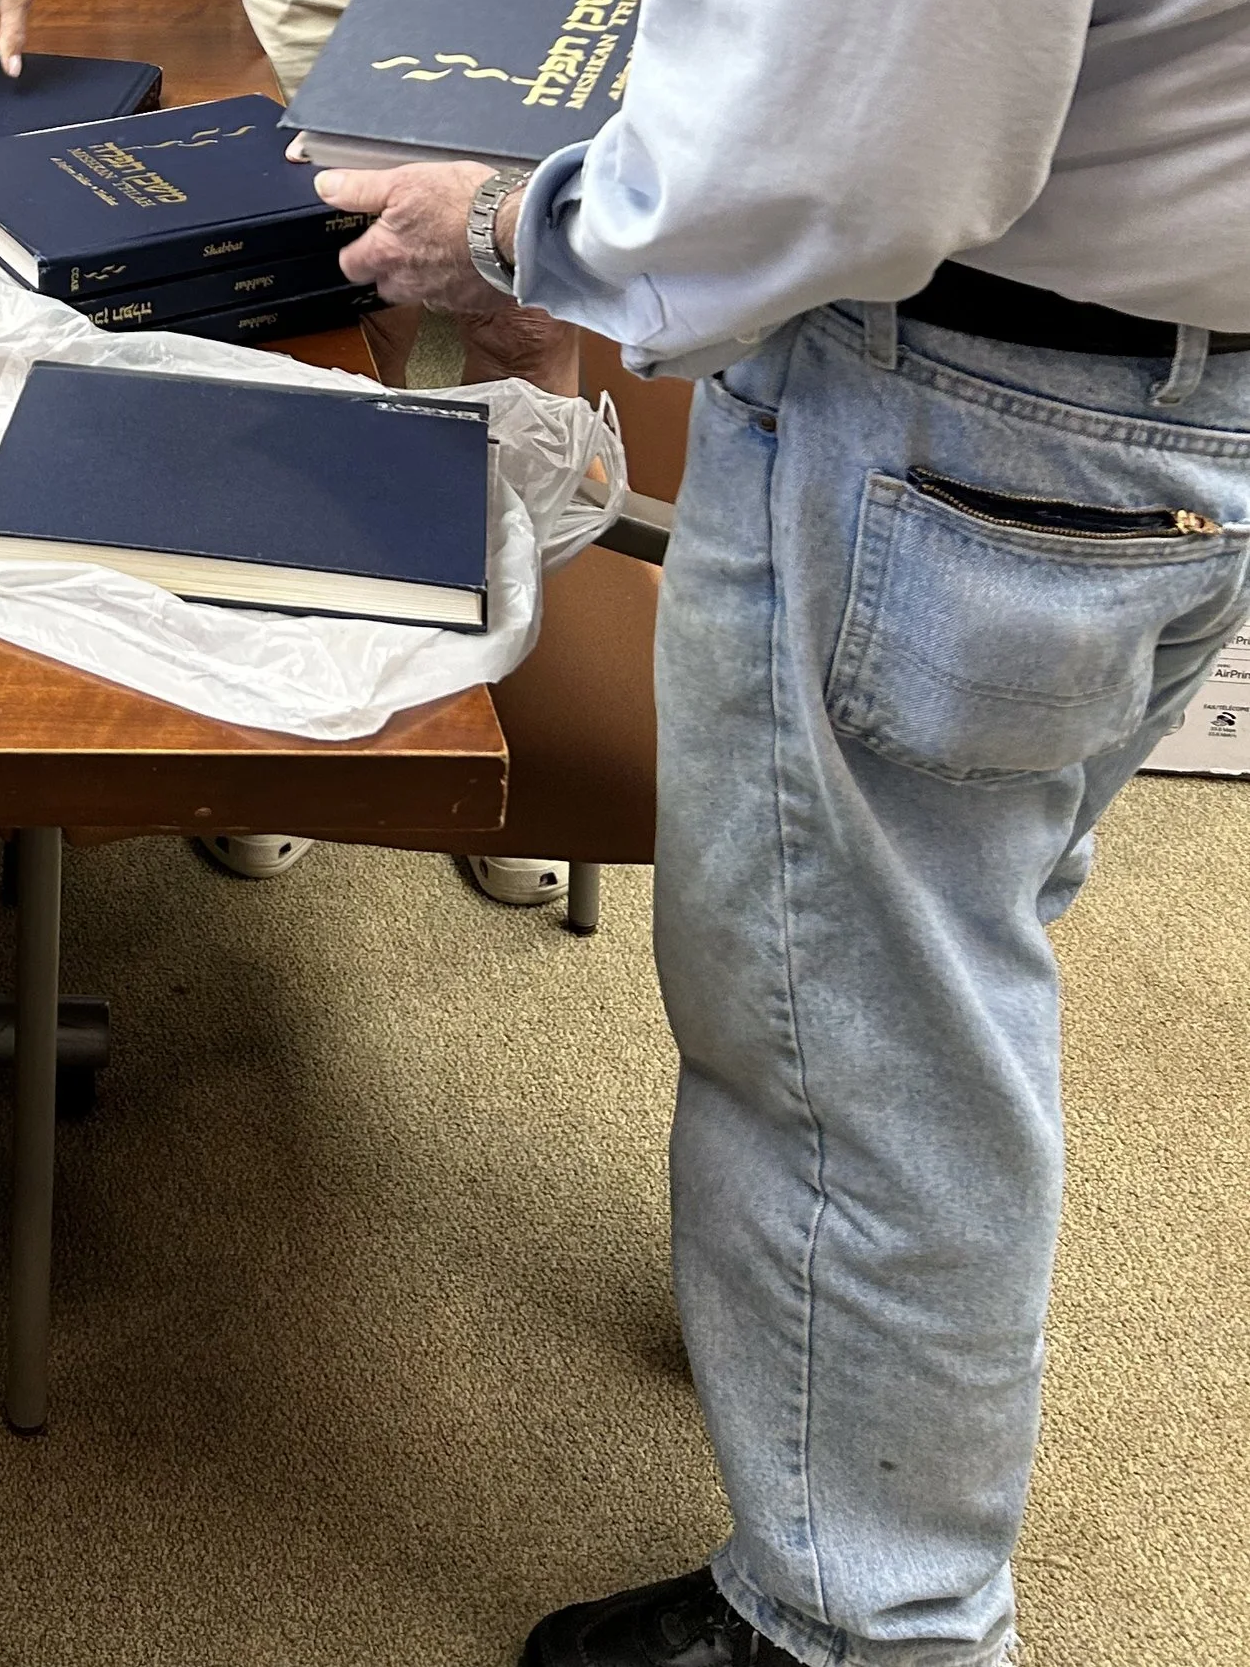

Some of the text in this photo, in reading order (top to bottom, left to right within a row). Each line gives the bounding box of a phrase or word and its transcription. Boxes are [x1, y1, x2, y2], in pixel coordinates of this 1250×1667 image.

[510, 34, 591, 107] תפלה
[564, 33, 620, 110] MISHKAN
[87, 141, 147, 174] תפלה
[120, 171, 188, 203] משכן
[203, 241, 244, 257] Shabbat
[70, 266, 80, 292] CCAR
[234, 274, 275, 291] Shabbat
[238, 312, 279, 328] Shabbat
